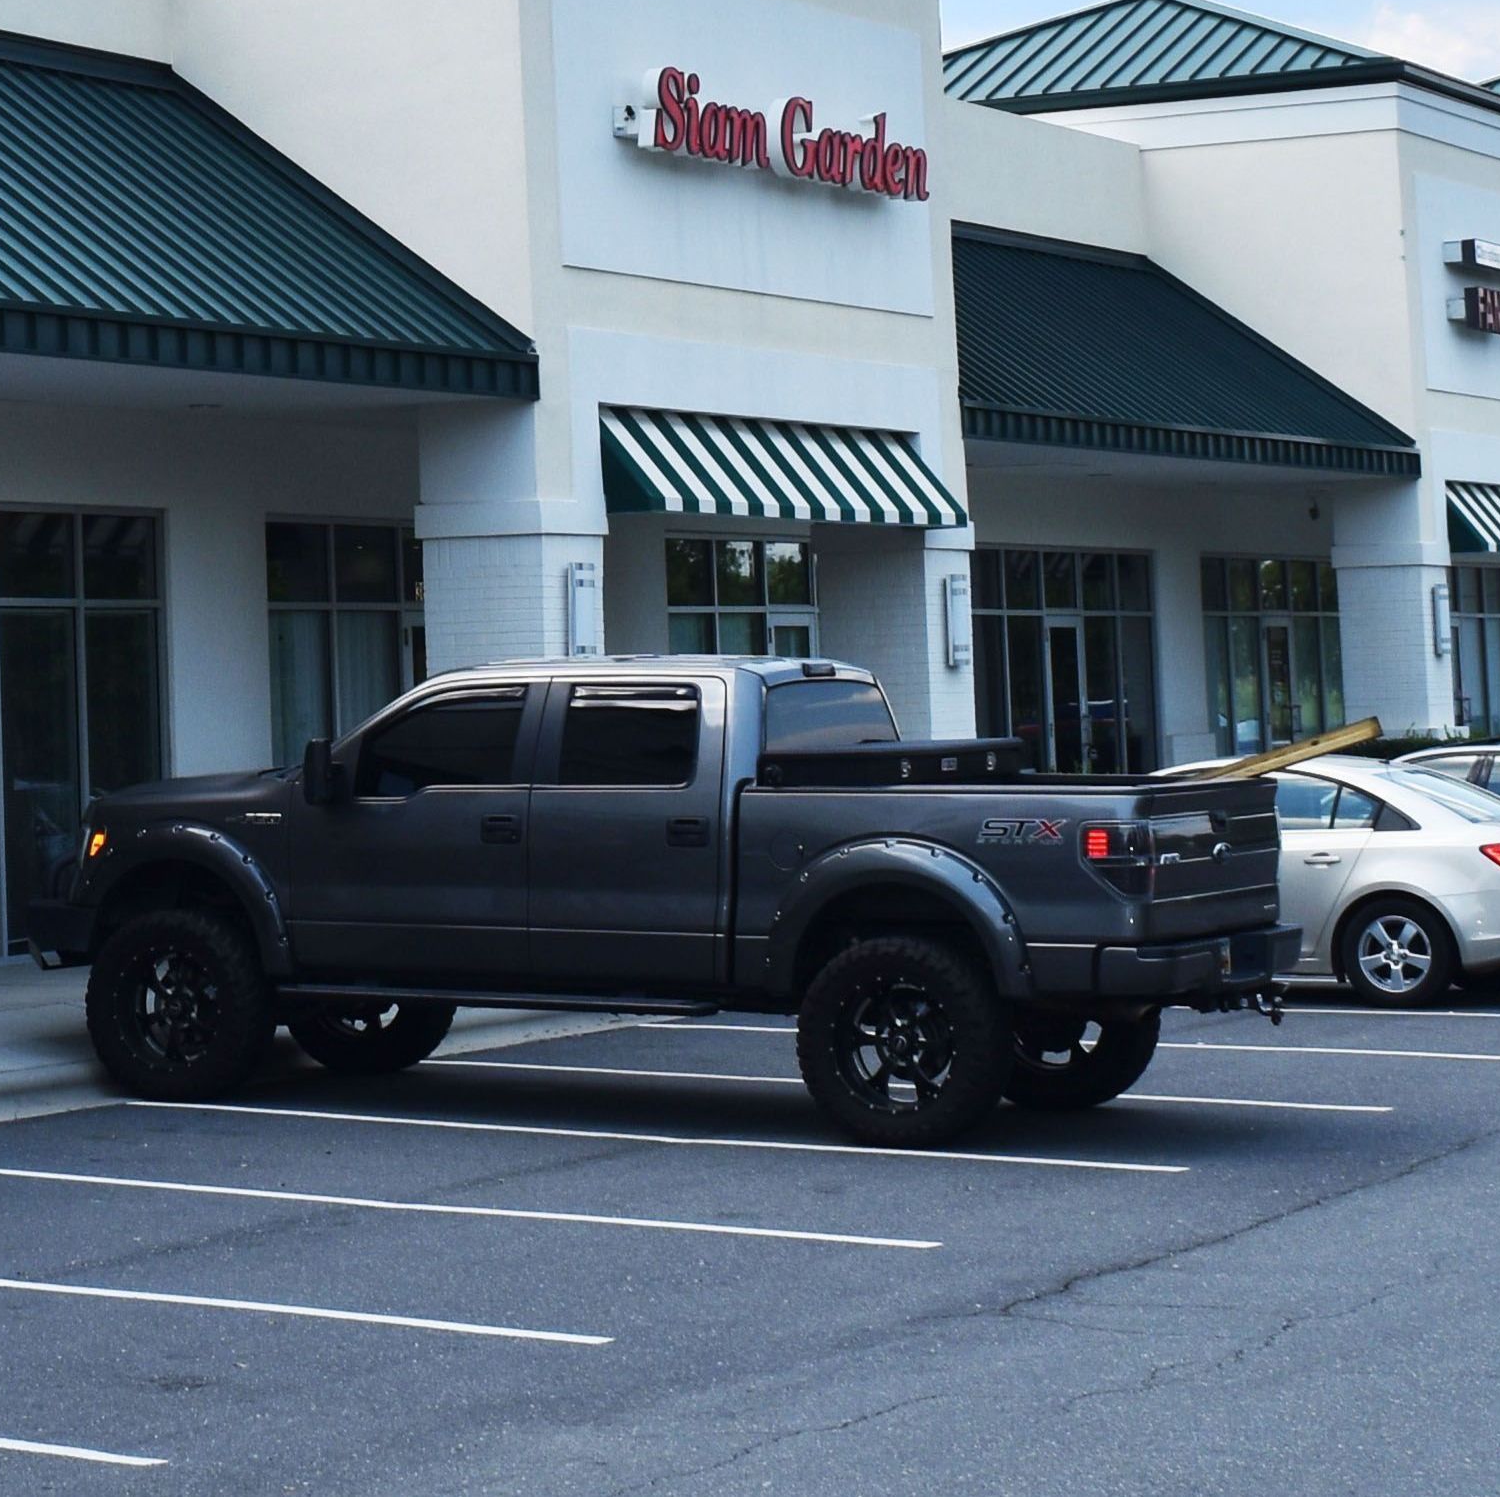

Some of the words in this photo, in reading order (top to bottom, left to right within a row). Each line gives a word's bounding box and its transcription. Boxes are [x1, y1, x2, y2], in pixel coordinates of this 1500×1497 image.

[653, 65, 770, 170] Siam
[779, 95, 930, 202] Garden
[979, 817, 1067, 839] STX
